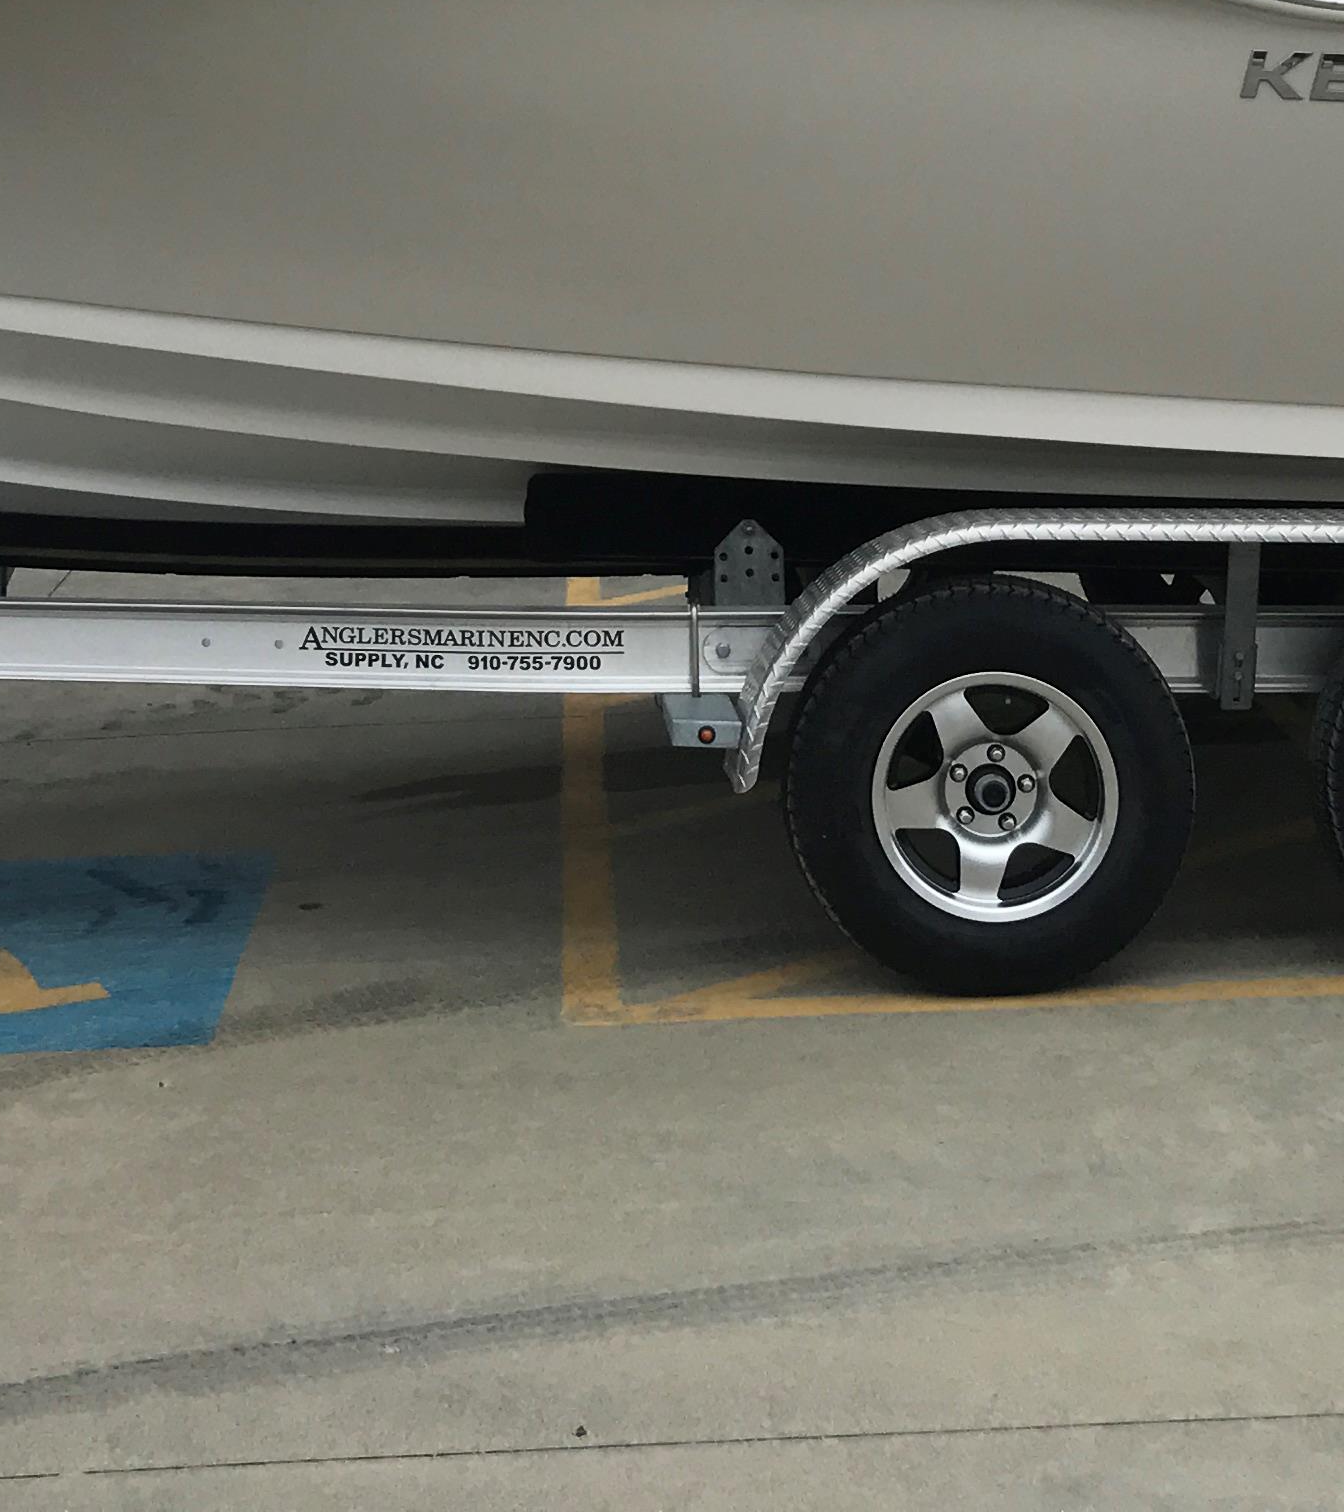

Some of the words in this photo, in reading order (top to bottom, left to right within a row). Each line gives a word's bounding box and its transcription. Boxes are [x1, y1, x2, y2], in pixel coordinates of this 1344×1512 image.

[299, 626, 625, 650] ANGLERSMARINENC.COM
[325, 652, 408, 670] SUPPLY,
[415, 654, 445, 670] NC
[468, 654, 602, 671] 910-755-7900
